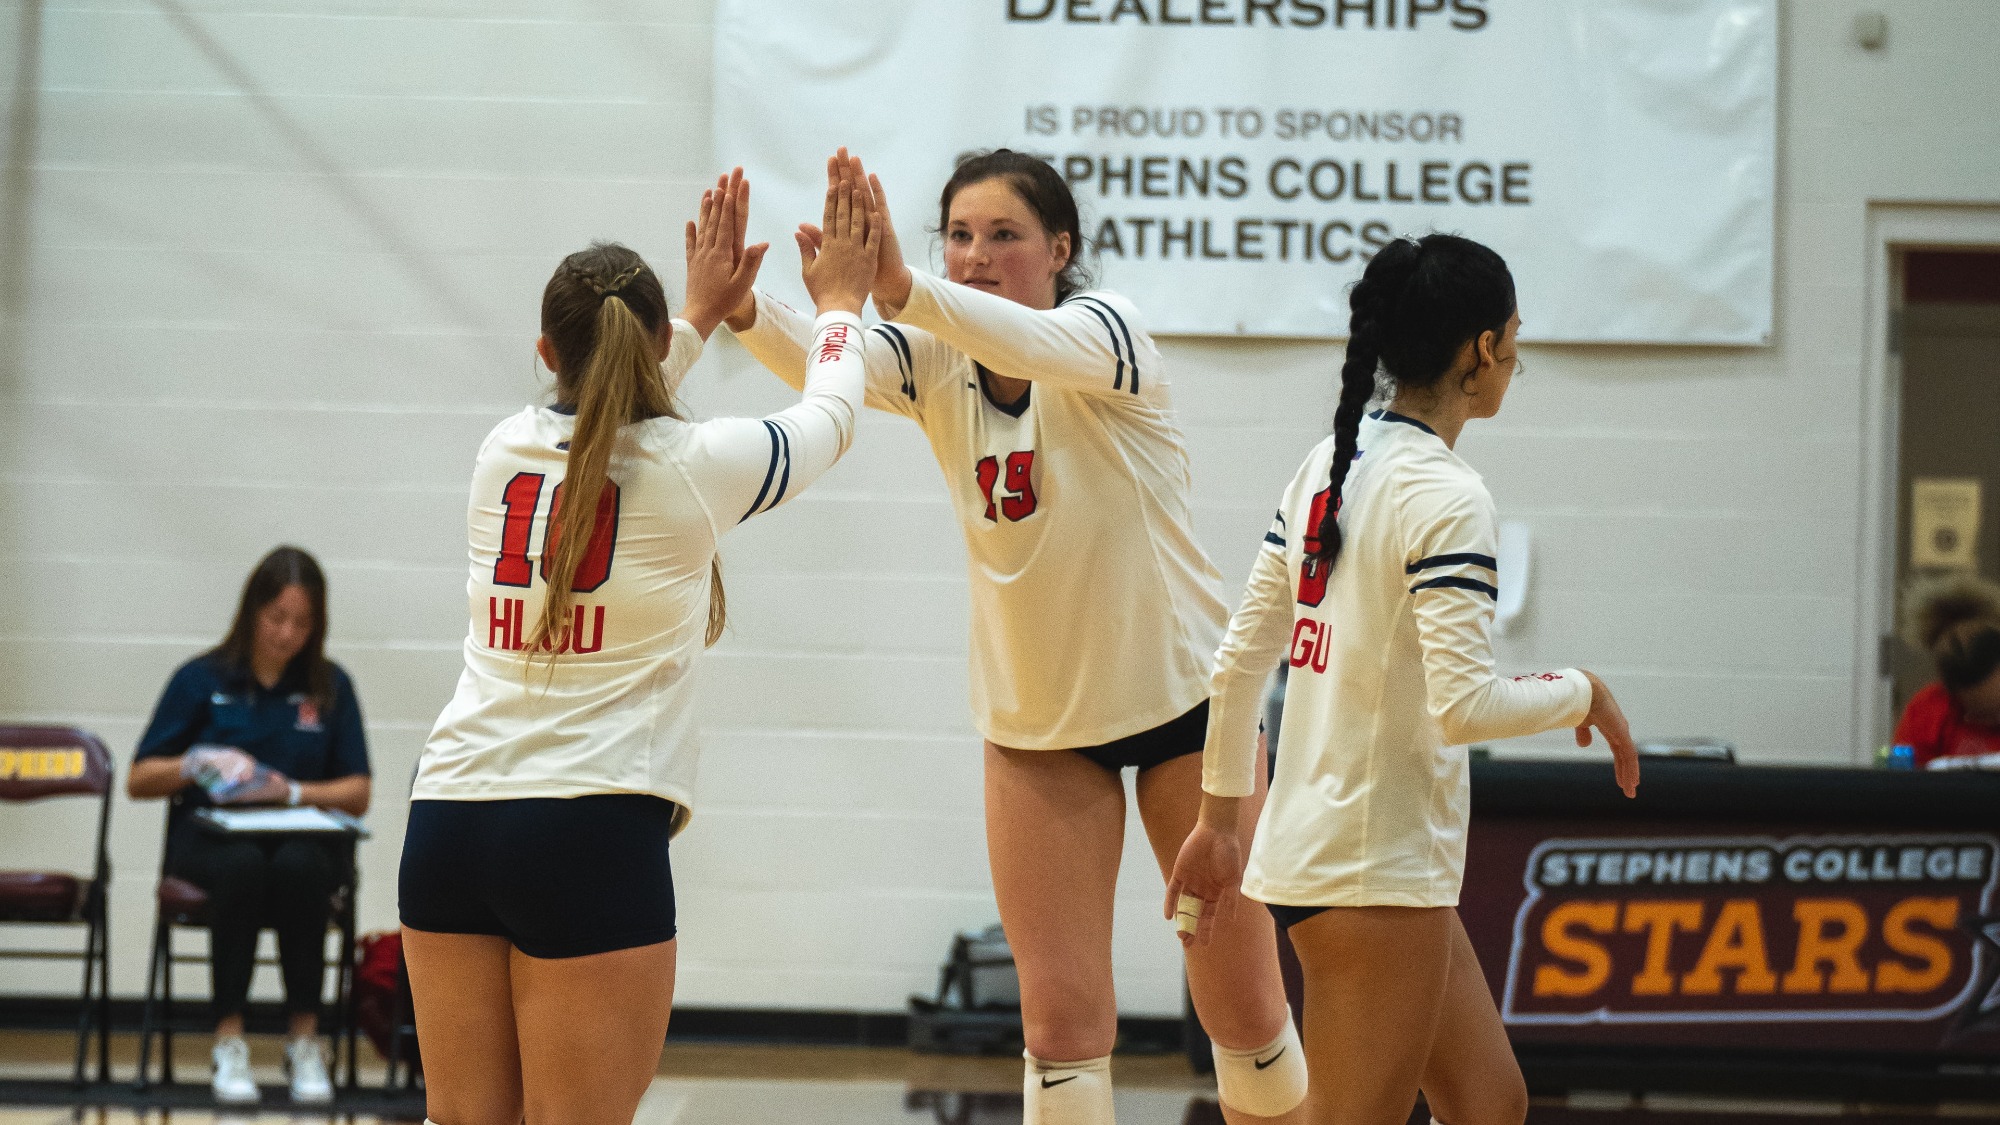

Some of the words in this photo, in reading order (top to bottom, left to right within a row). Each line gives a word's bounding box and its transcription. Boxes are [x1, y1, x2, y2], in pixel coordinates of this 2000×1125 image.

[1025, 105, 1059, 134] IS
[1073, 106, 1202, 138] PROUD
[1216, 108, 1263, 139] TO
[1274, 111, 1463, 142] SPONSOR
[955, 153, 1248, 199] PHENS
[1267, 158, 1532, 204] COLLEGE
[1091, 217, 1390, 262] ATHLETICS
[975, 450, 1038, 523] 19
[1540, 851, 1773, 886] STEPHENS
[1783, 847, 1985, 881] COLLEGE
[1532, 897, 1961, 997] STARS
